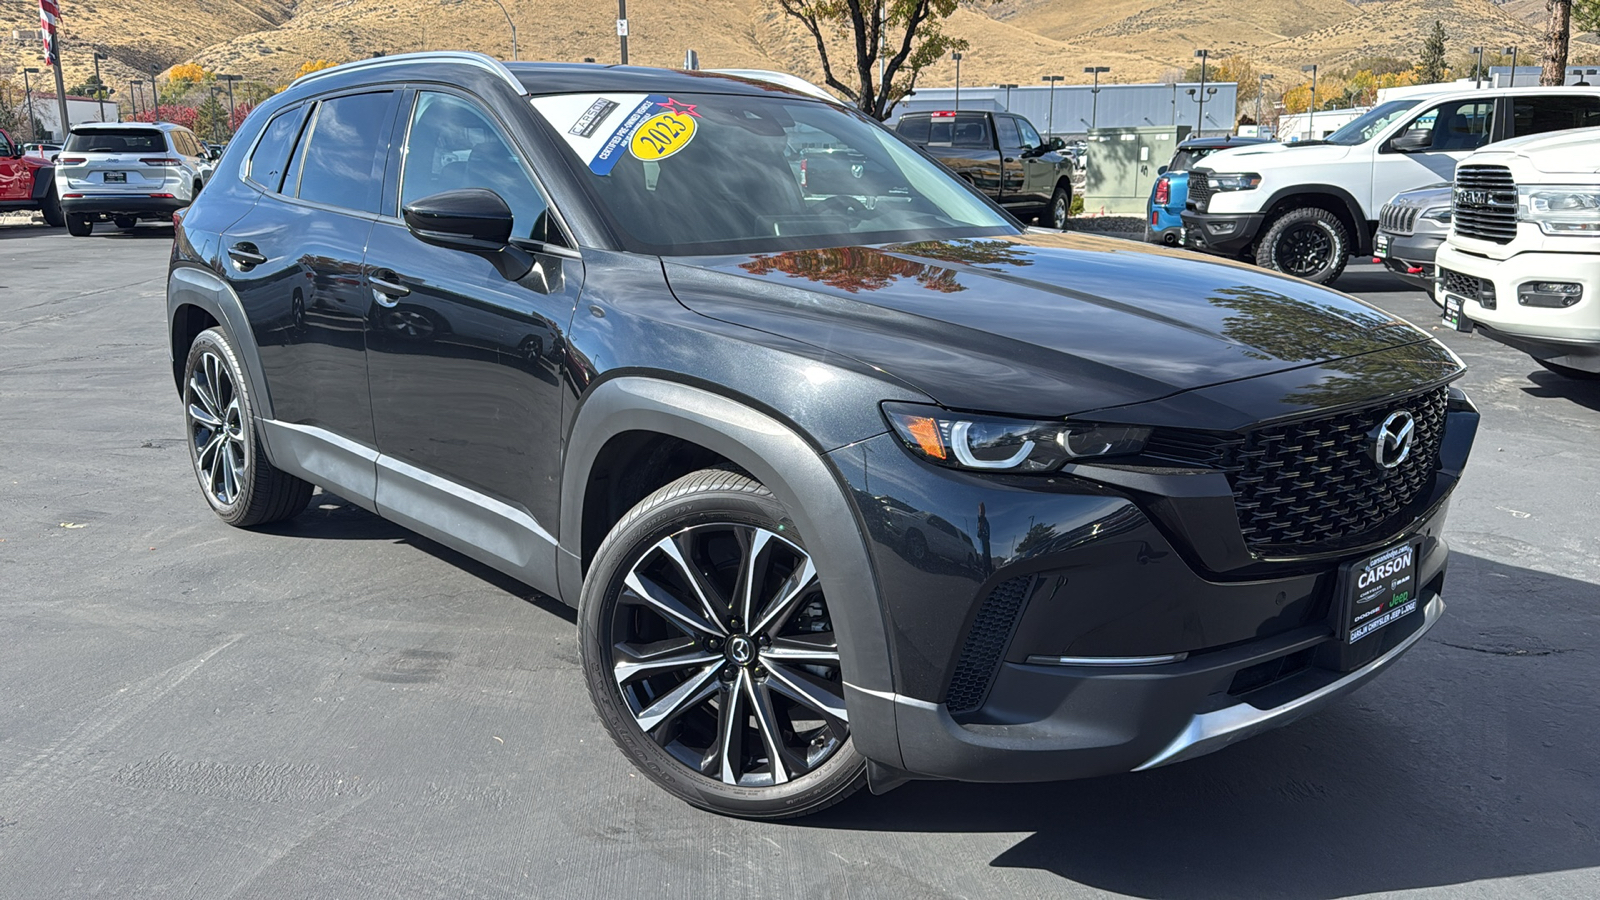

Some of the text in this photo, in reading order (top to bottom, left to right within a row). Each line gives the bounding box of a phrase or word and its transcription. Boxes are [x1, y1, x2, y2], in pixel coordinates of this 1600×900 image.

[572, 98, 609, 134] CARSON
[599, 135, 622, 160] CERTIFIED
[616, 113, 640, 137] PRE-OWNED
[635, 100, 654, 115] VEHICLE
[640, 115, 687, 155] 2023
[1459, 190, 1487, 204] RAM
[1358, 552, 1411, 589] CARSON
[1360, 575, 1410, 598] CHRYSLER RAM
[1354, 591, 1409, 622] DODGE Jeep
[1368, 614, 1390, 631] CHRYSLER
